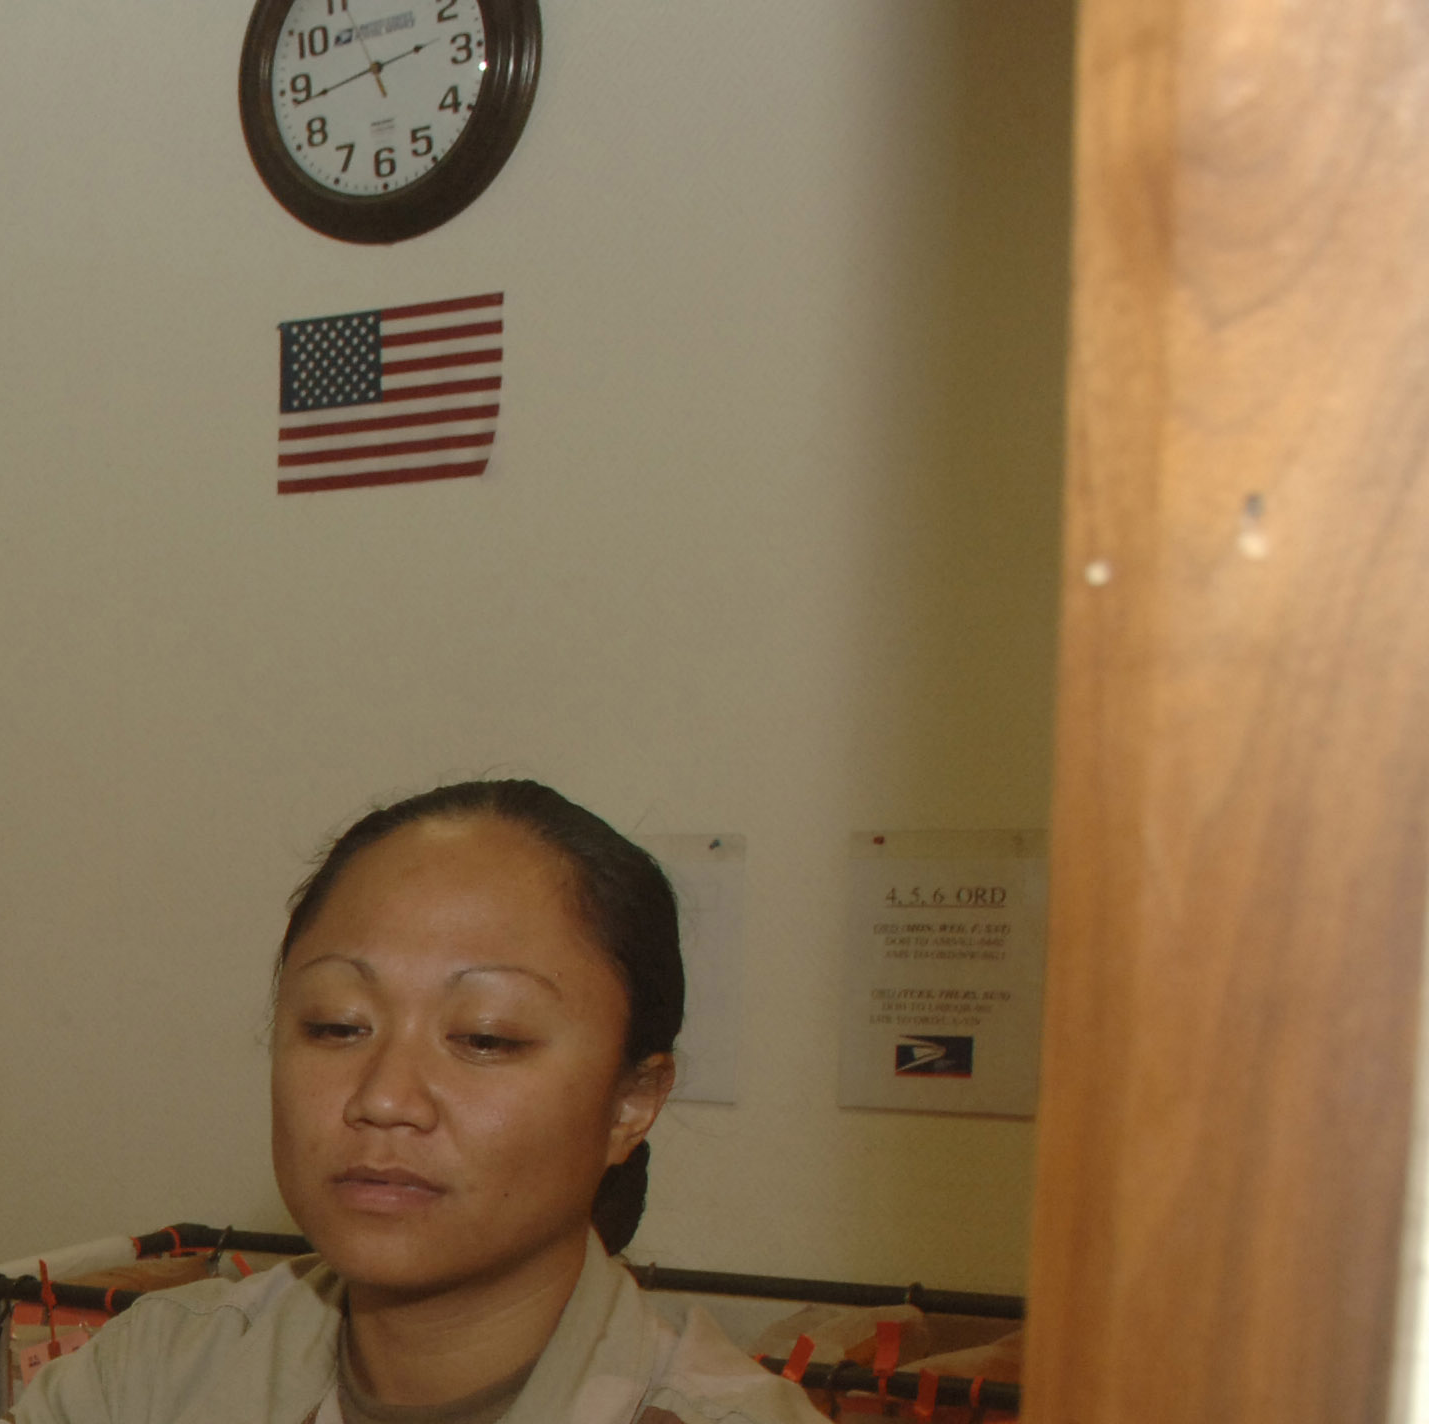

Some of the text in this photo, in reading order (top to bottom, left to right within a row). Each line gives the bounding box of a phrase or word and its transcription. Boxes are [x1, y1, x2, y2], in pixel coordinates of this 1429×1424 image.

[298, 26, 329, 59] 10
[450, 33, 472, 65] 3
[290, 74, 312, 105] 9
[438, 85, 462, 114] 4
[306, 117, 329, 147] 8
[410, 125, 434, 157] 5
[335, 143, 355, 173] 7
[374, 147, 396, 178] 6
[956, 886, 1007, 904] ORD
